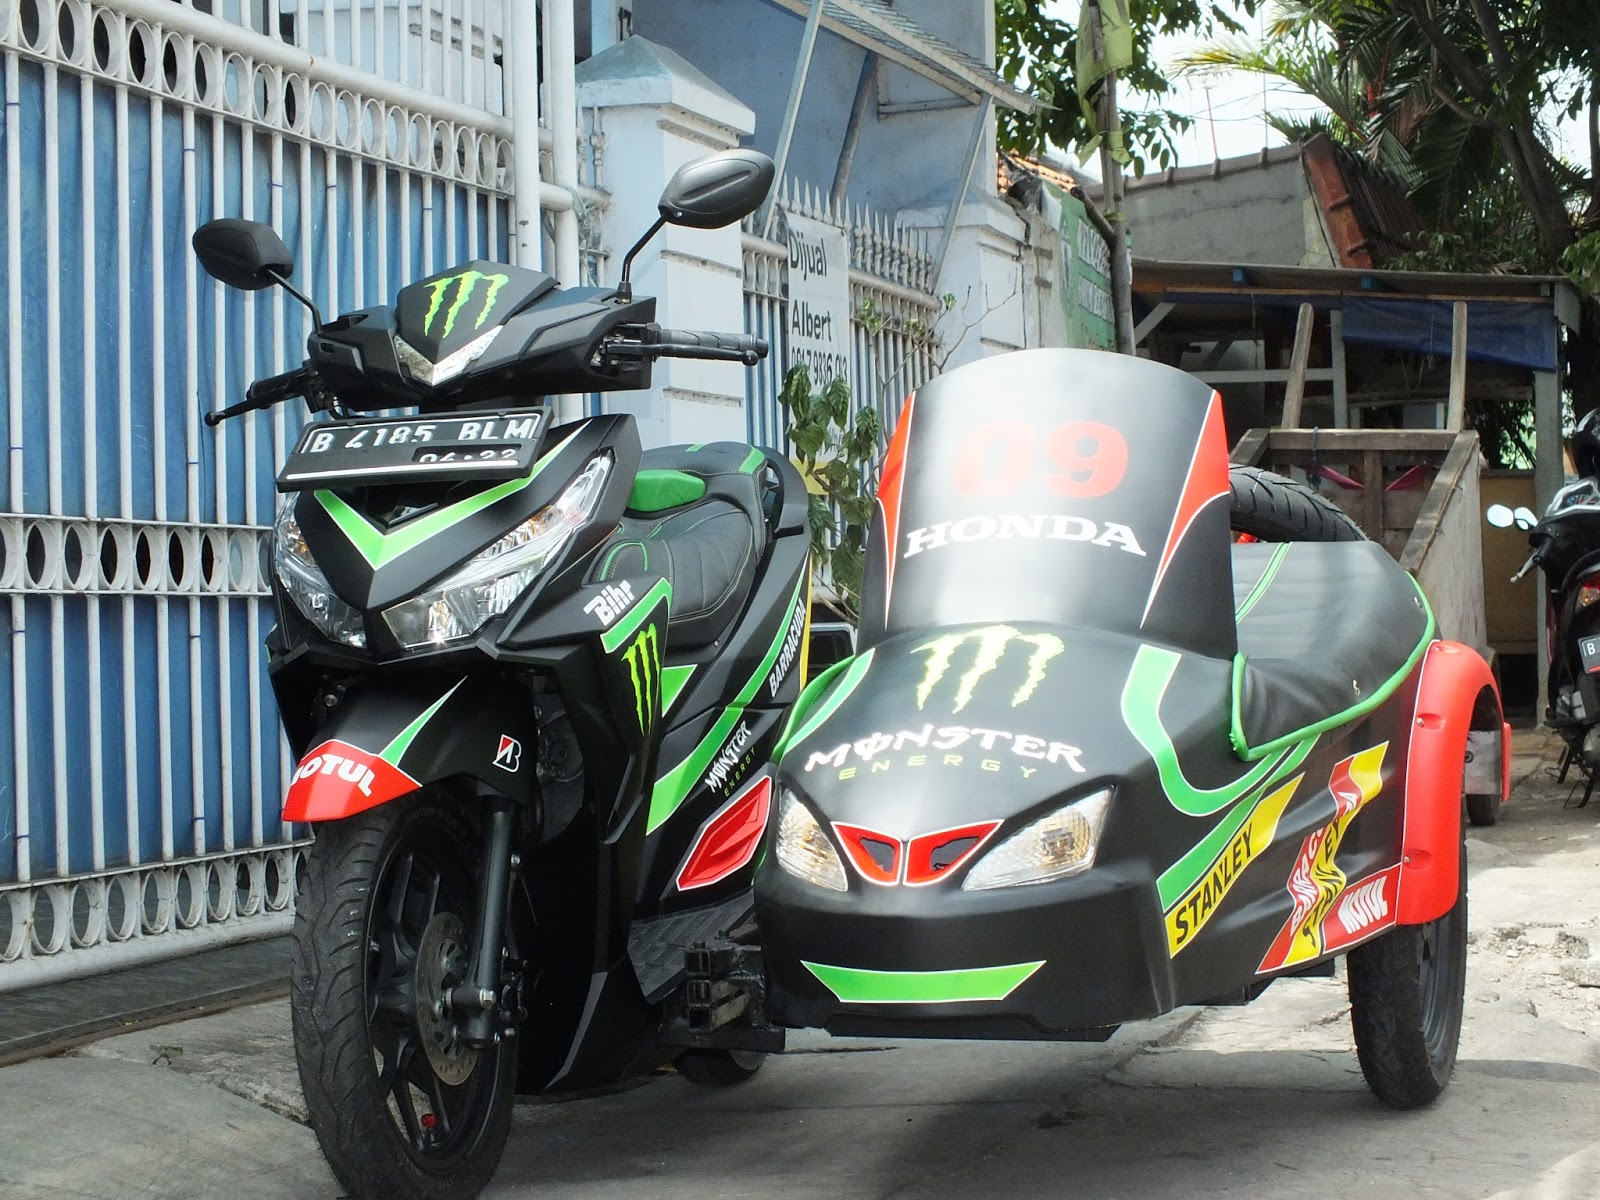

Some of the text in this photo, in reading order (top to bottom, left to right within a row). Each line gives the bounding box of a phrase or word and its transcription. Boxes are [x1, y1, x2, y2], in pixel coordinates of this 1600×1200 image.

[788, 228, 828, 281] Dijual
[791, 299, 832, 342] Albert
[310, 432, 335, 453] B
[458, 418, 534, 442] BLM
[954, 421, 1129, 499] 09
[903, 514, 1147, 559] HONDA
[583, 580, 636, 626] Bihr
[768, 597, 807, 698] BARRACUDA
[1587, 642, 1596, 656] B
[704, 720, 752, 793] MONSTER
[723, 748, 755, 797] ENERGY
[804, 724, 1087, 773] MONSTER
[838, 754, 1038, 781] ENERGY
[1175, 822, 1254, 945] STANLEY
[1337, 876, 1389, 935] MOTUL
